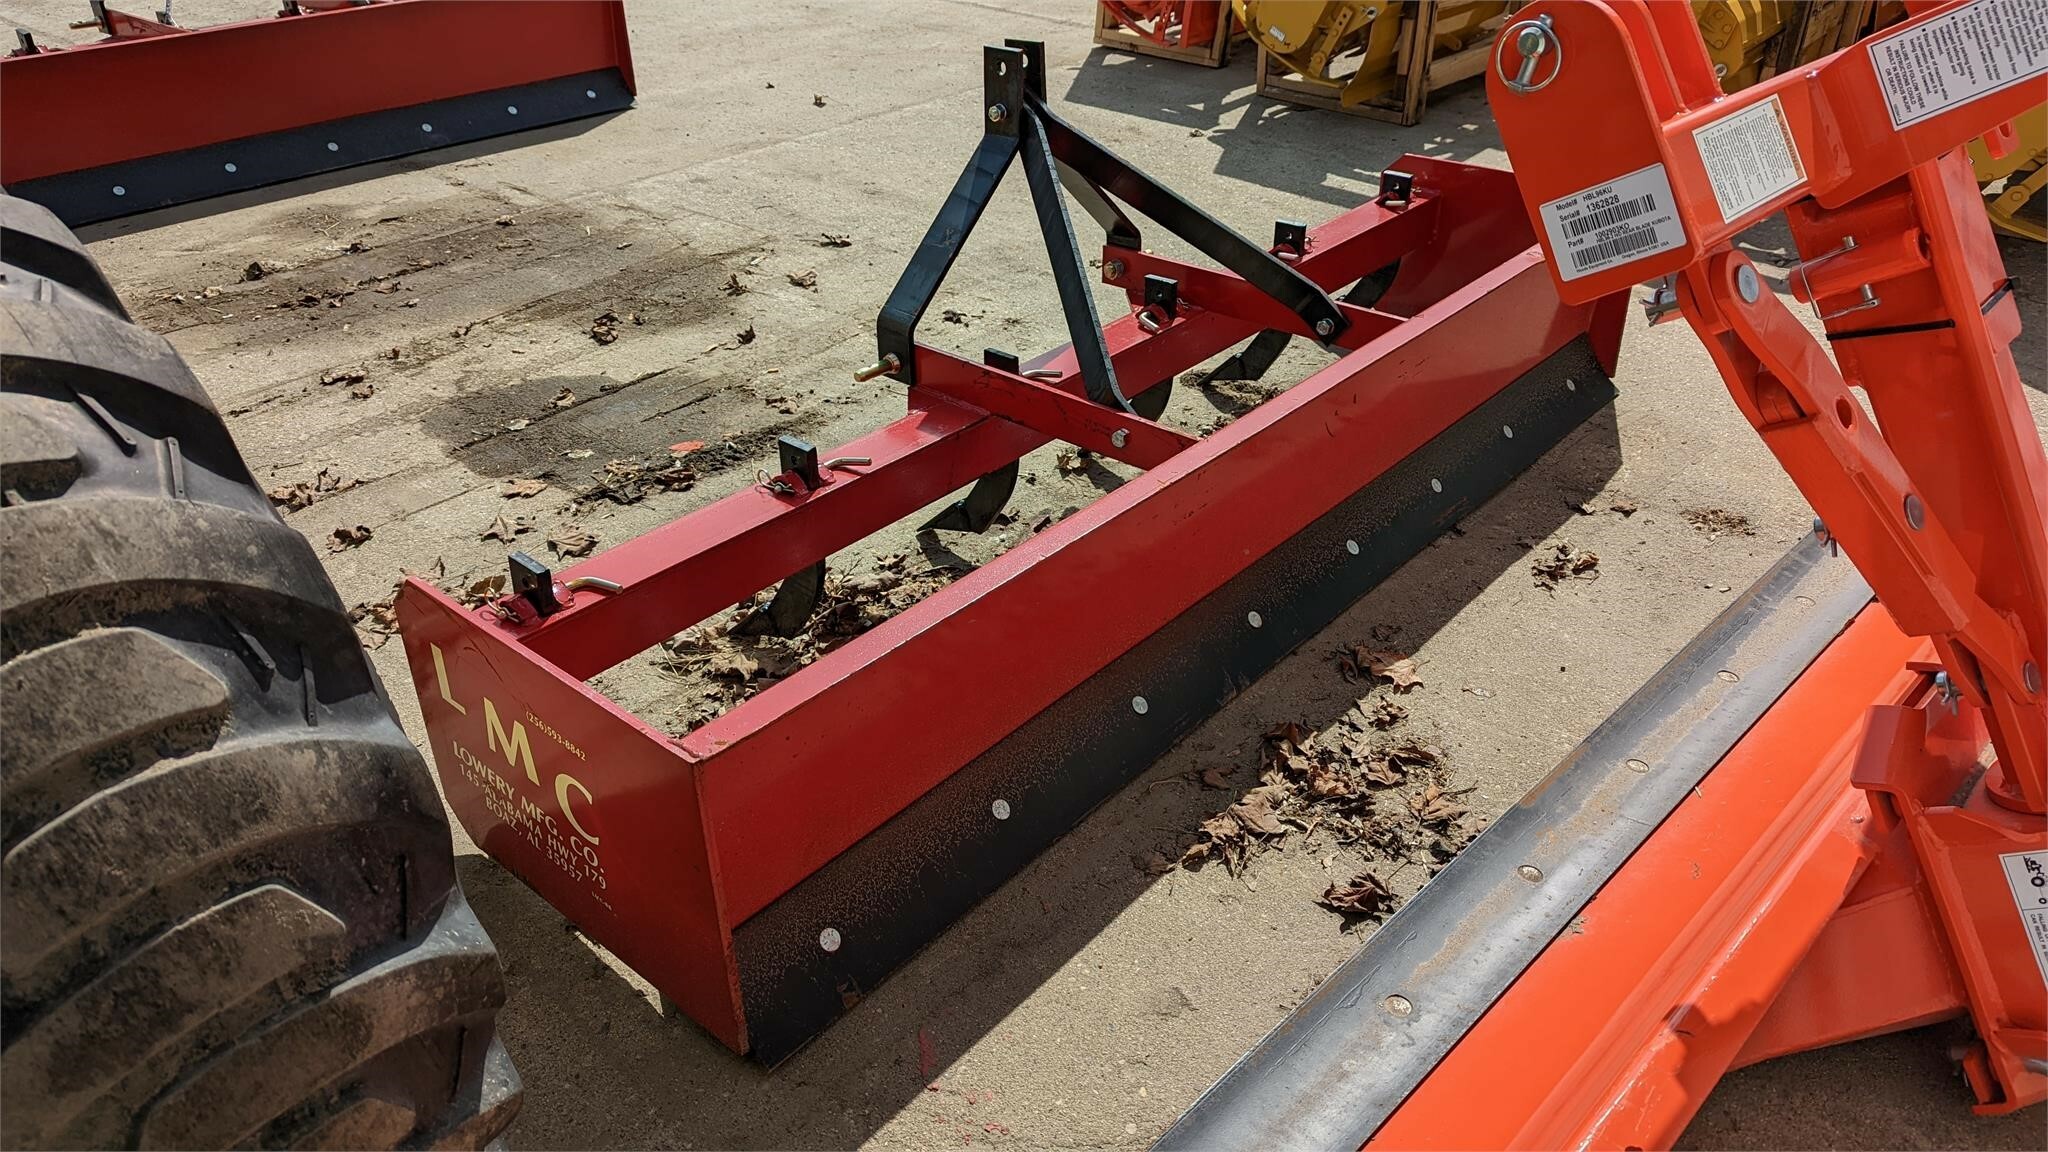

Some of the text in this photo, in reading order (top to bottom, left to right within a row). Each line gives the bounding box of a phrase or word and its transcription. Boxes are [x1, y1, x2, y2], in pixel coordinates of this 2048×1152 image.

[1938, 26, 1948, 46] between
[1945, 47, 1953, 63] tractor
[1984, 7, 1993, 23] tractor
[1989, 24, 1997, 35] seat
[1991, 4, 2000, 24] Operate
[1998, 24, 2006, 40] tractor
[2003, 42, 2013, 62] controls
[2028, 35, 2036, 50] could
[1898, 39, 1925, 108] FAILURE TO FOLLOW THESE
[1914, 52, 1922, 68] raised
[1921, 74, 1931, 94] lowered.
[1918, 41, 1928, 64] operation
[1927, 71, 1935, 84] when
[1922, 32, 1931, 47] Stand
[1934, 66, 1943, 87] machine
[1945, 23, 1965, 76] engaged before going
[1959, 46, 1969, 65] parking
[1966, 64, 1974, 79] brake
[1971, 24, 1983, 50] implement
[1984, 64, 1993, 80] tractor
[1980, 28, 1989, 42] stand
[1985, 42, 1995, 63] between
[1992, 63, 2000, 80] tractor
[1885, 45, 1895, 65] RESULT
[1894, 72, 1905, 94] SERIOUS
[1901, 95, 1911, 112] INJURY
[1885, 67, 1897, 94] OR DEATH.
[1894, 49, 1916, 104] INSTRUCTIONS COULD
[1555, 186, 1612, 210] Model# HBL96KU
[1559, 194, 1620, 222] Serial# 1362828
[1635, 222, 1650, 230] BLADE
[1651, 215, 1671, 224] KUBOTA
[1567, 237, 1584, 248] Part#
[430, 642, 599, 846] L M C
[526, 711, 586, 761] (256)593-8842
[453, 741, 605, 873] LOWERY MFG. CO.
[460, 763, 479, 787] 145
[548, 834, 578, 866] HWY
[584, 864, 606, 889] 179
[486, 797, 583, 882] BOAZ, AL 35957
